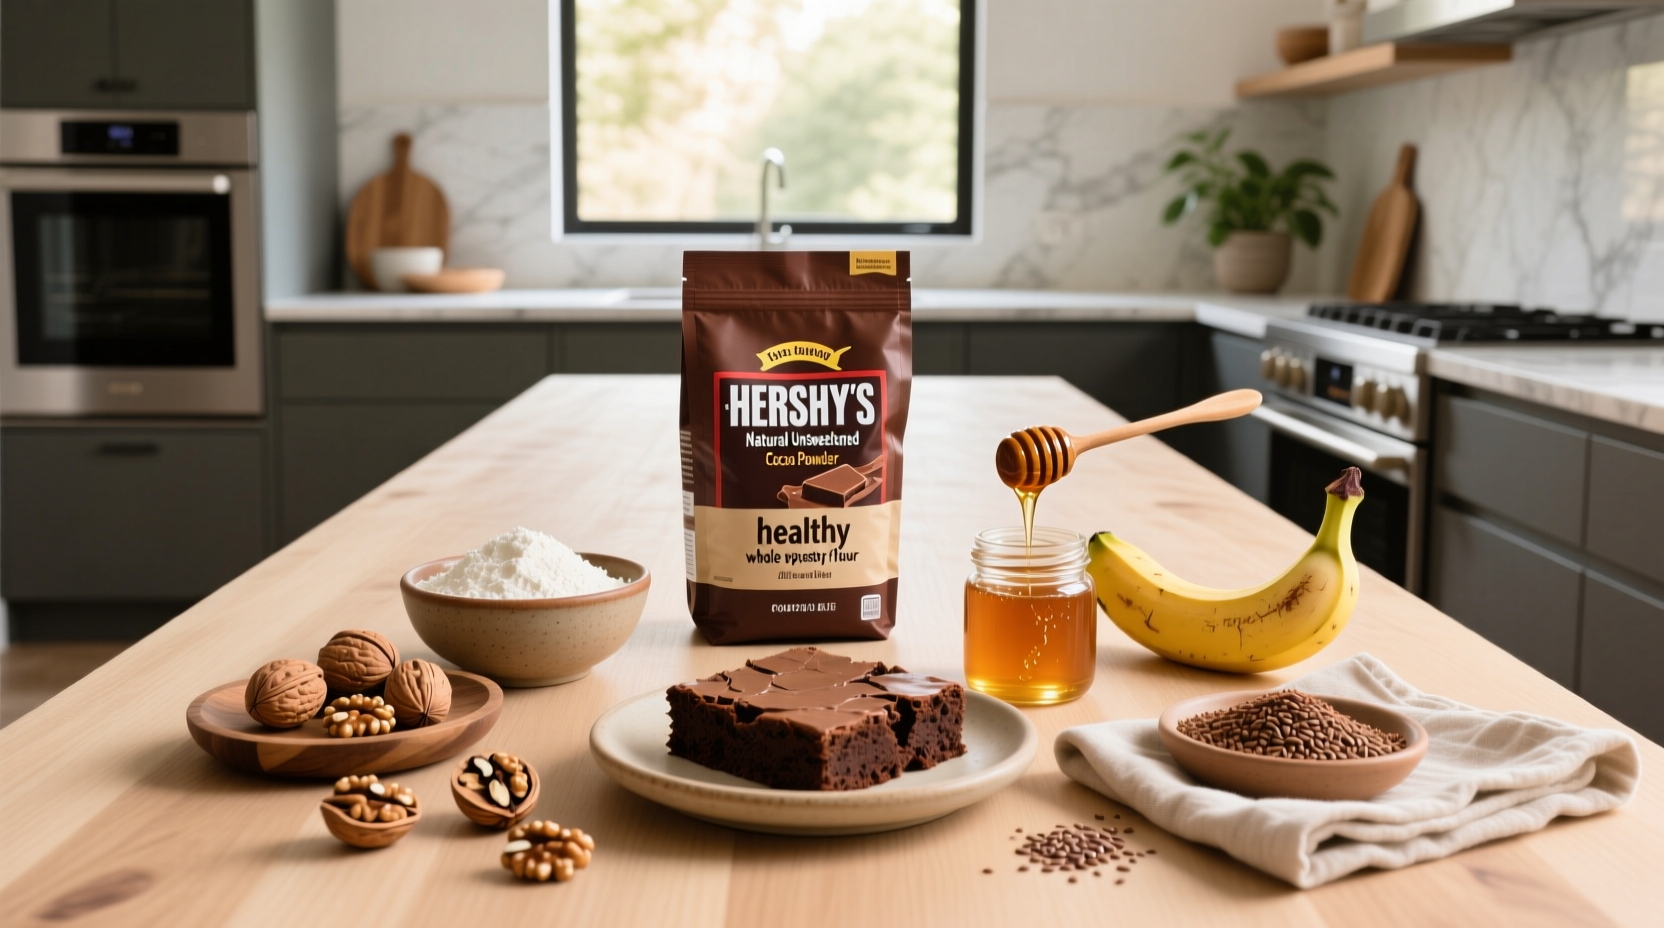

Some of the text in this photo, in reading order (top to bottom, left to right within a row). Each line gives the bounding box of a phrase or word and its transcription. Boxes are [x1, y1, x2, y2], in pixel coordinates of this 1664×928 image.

[730, 383, 875, 427] HERSHY'S
[746, 431, 788, 447] Natural
[757, 515, 850, 550] healthy
[746, 549, 781, 564] whole
